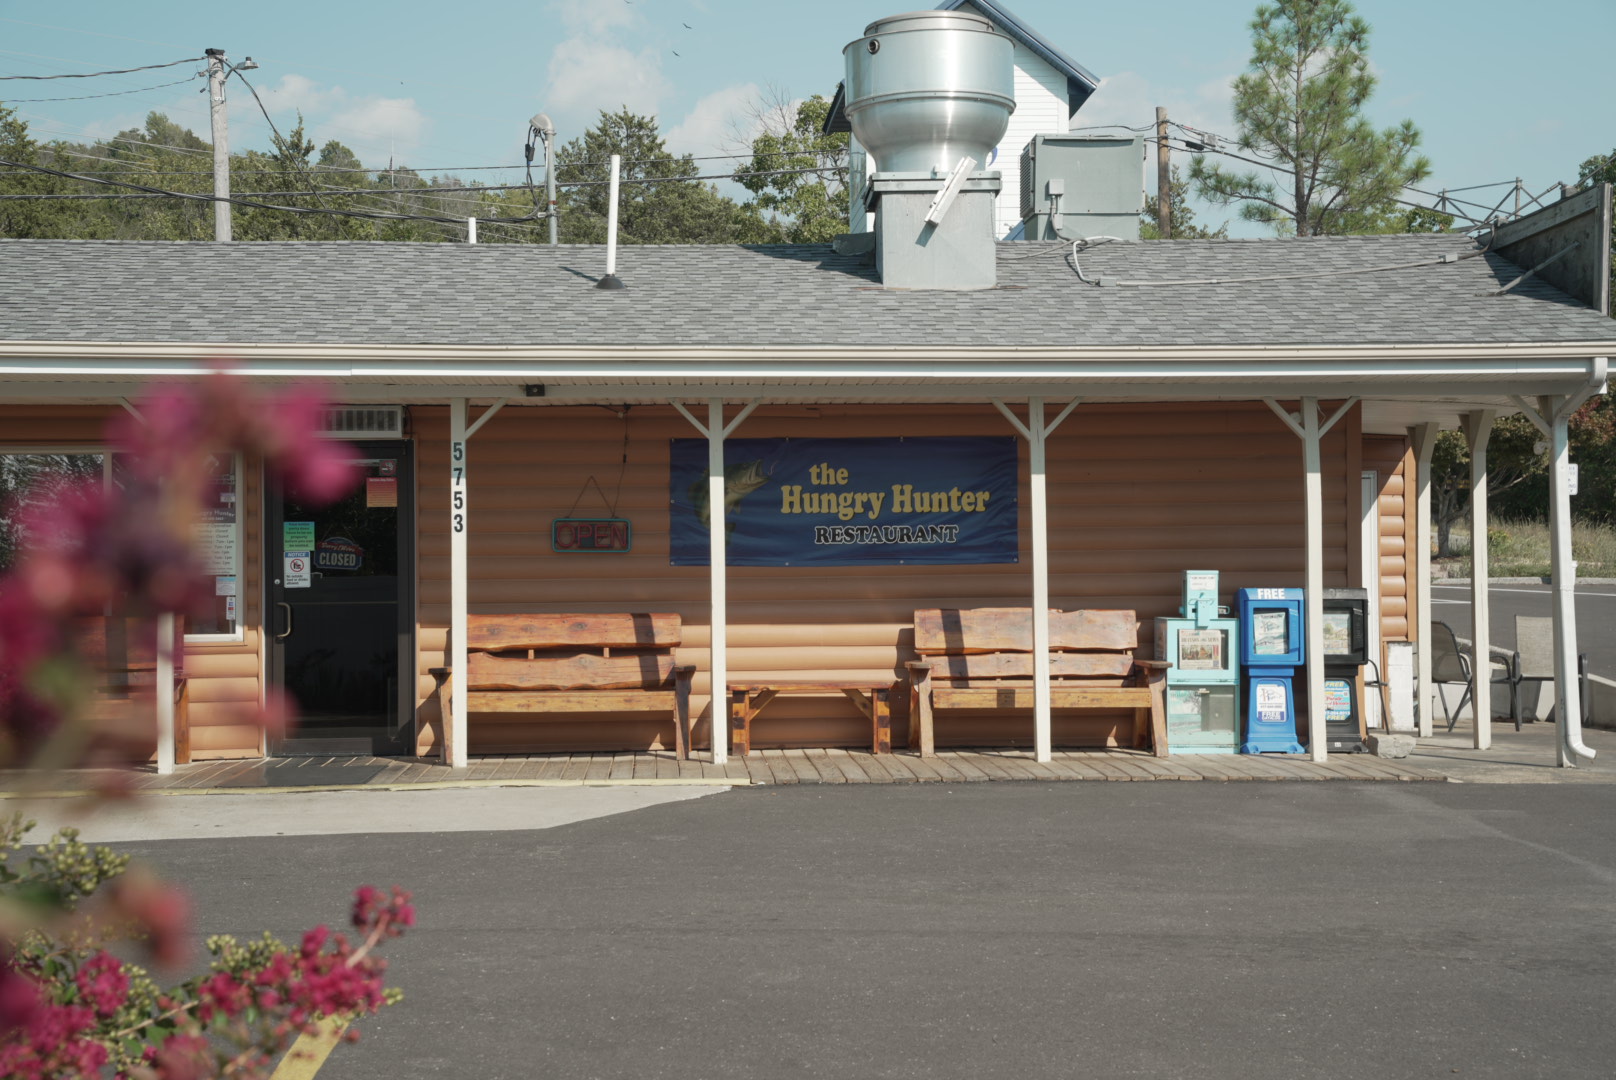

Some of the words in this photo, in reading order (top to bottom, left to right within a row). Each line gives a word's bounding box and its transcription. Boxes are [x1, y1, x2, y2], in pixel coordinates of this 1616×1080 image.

[809, 462, 849, 485] the
[453, 442, 463, 533] 5753
[781, 485, 885, 521] Hungry
[891, 484, 990, 513] Hunter
[557, 524, 627, 547] OPEN
[814, 525, 959, 544] RESTAURANT
[320, 552, 356, 566] CLOSED
[1257, 588, 1285, 600] FREE
